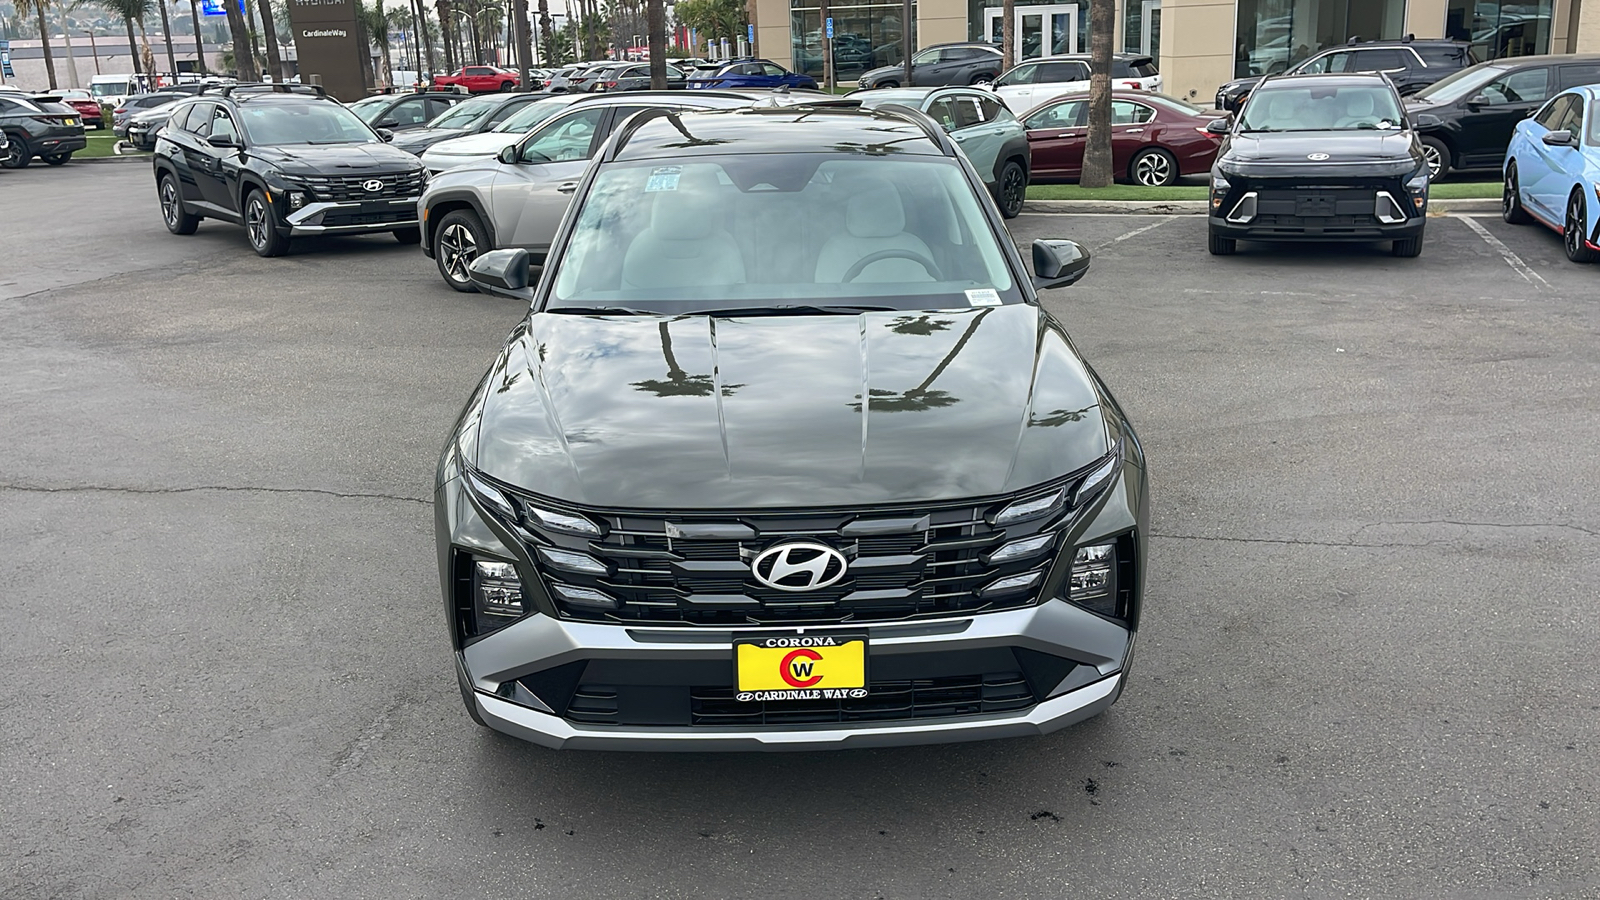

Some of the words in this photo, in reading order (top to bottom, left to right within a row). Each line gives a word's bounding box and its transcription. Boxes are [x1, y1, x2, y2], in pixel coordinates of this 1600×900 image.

[302, 29, 347, 37] CardinaleWay
[766, 637, 836, 647] CORONA
[754, 689, 821, 701] CARDINALE
[823, 689, 849, 699] WAY
